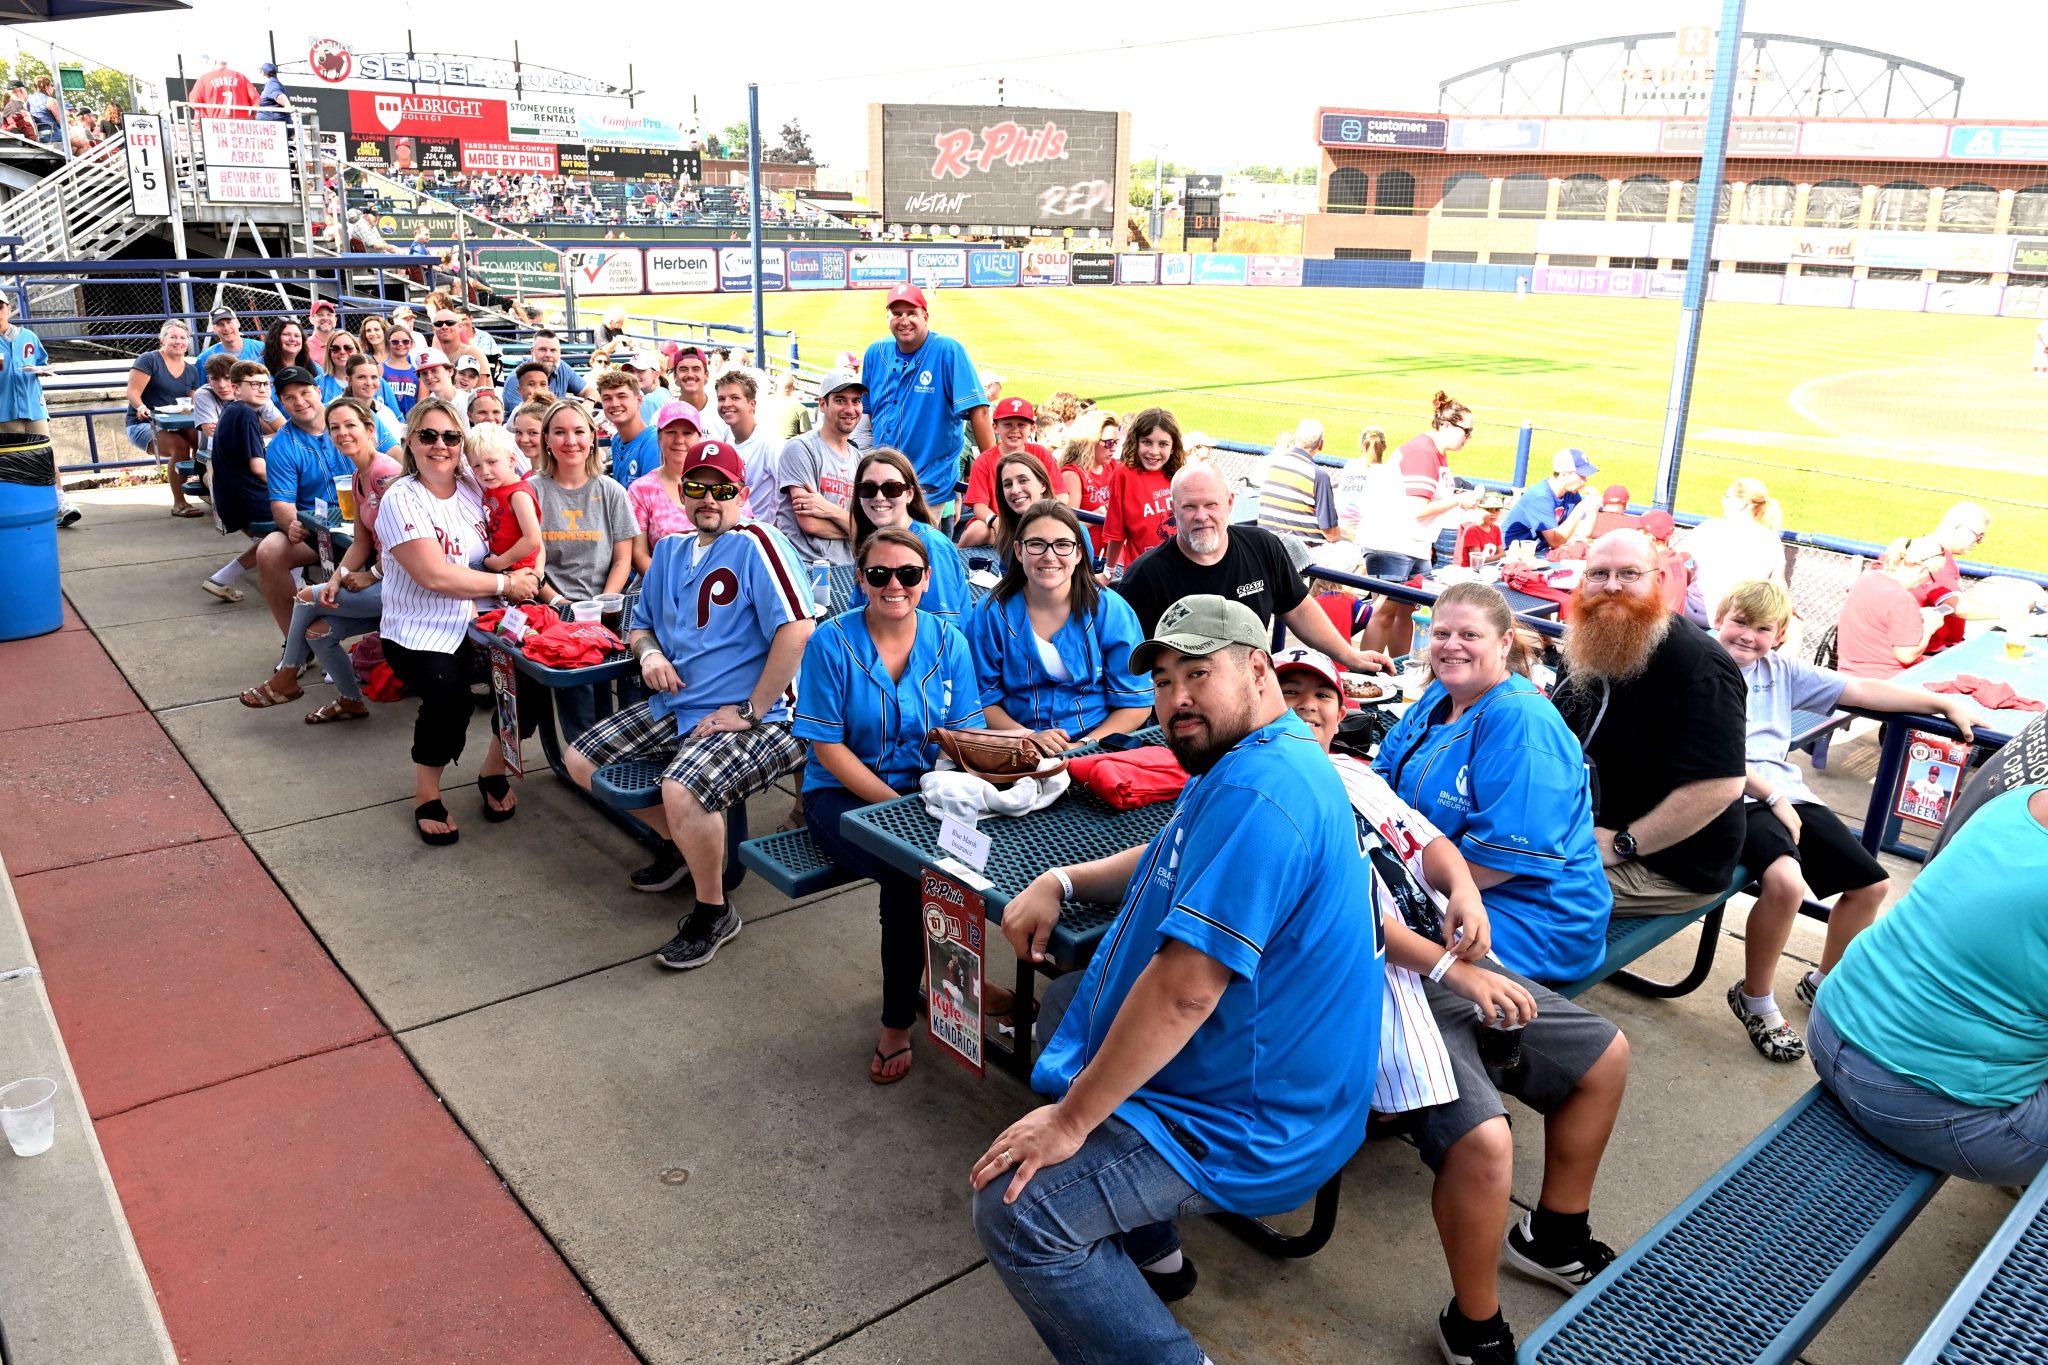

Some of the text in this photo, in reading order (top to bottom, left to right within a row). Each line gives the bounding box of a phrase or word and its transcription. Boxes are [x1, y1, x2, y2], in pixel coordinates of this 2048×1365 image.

[360, 54, 488, 87] SEIDEL
[289, 95, 318, 104] mbers
[401, 97, 483, 117] ALBRIGHT
[510, 102, 575, 115] STONEY CREEK
[402, 113, 442, 122] COLLEGE
[534, 113, 576, 124] RENTALS
[602, 115, 661, 130] ComfortPro
[212, 122, 277, 136] NO SMOKING
[1368, 119, 1428, 133] customers
[130, 134, 157, 146] LEFT
[217, 137, 274, 150] IN SEATING
[351, 134, 385, 142] ALUMNI
[421, 137, 454, 145] REPORT
[1367, 131, 1397, 144] bank
[464, 142, 554, 154] YARDS BREWING COMPANY
[931, 120, 1069, 180] R-Phils
[141, 148, 149, 167] 1
[231, 151, 264, 164] AREAS
[468, 153, 551, 167] MADE BY PHILA
[142, 172, 156, 190] 5
[220, 171, 277, 184] BEWARE OF
[221, 185, 281, 198] FOUL BALLS
[1039, 180, 1114, 215] REP
[1188, 188, 1220, 197] FROMM
[905, 192, 972, 214] INSTANT
[401, 220, 470, 230] LIVE UNITD
[653, 256, 708, 270] Herbein
[822, 256, 844, 265] DRIVE
[982, 254, 1015, 270] UECU
[1037, 253, 1068, 265] SOLD
[481, 261, 543, 274] TOMPKINS
[790, 260, 819, 272] Unruh
[822, 264, 844, 272] HOME
[655, 279, 708, 287] www.herbein.com
[1544, 272, 1608, 290] TRUIST
[561, 509, 583, 530] T
[542, 530, 603, 542] TENNESSEE
[1183, 640, 1216, 651] INFANTRY
[1439, 790, 1458, 802] Blue
[1901, 800, 1939, 820] GREEN
[924, 876, 965, 907] R-Phils
[966, 921, 981, 950] 12
[932, 990, 962, 1022] Kyle
[933, 1014, 979, 1062] KENDRICK
